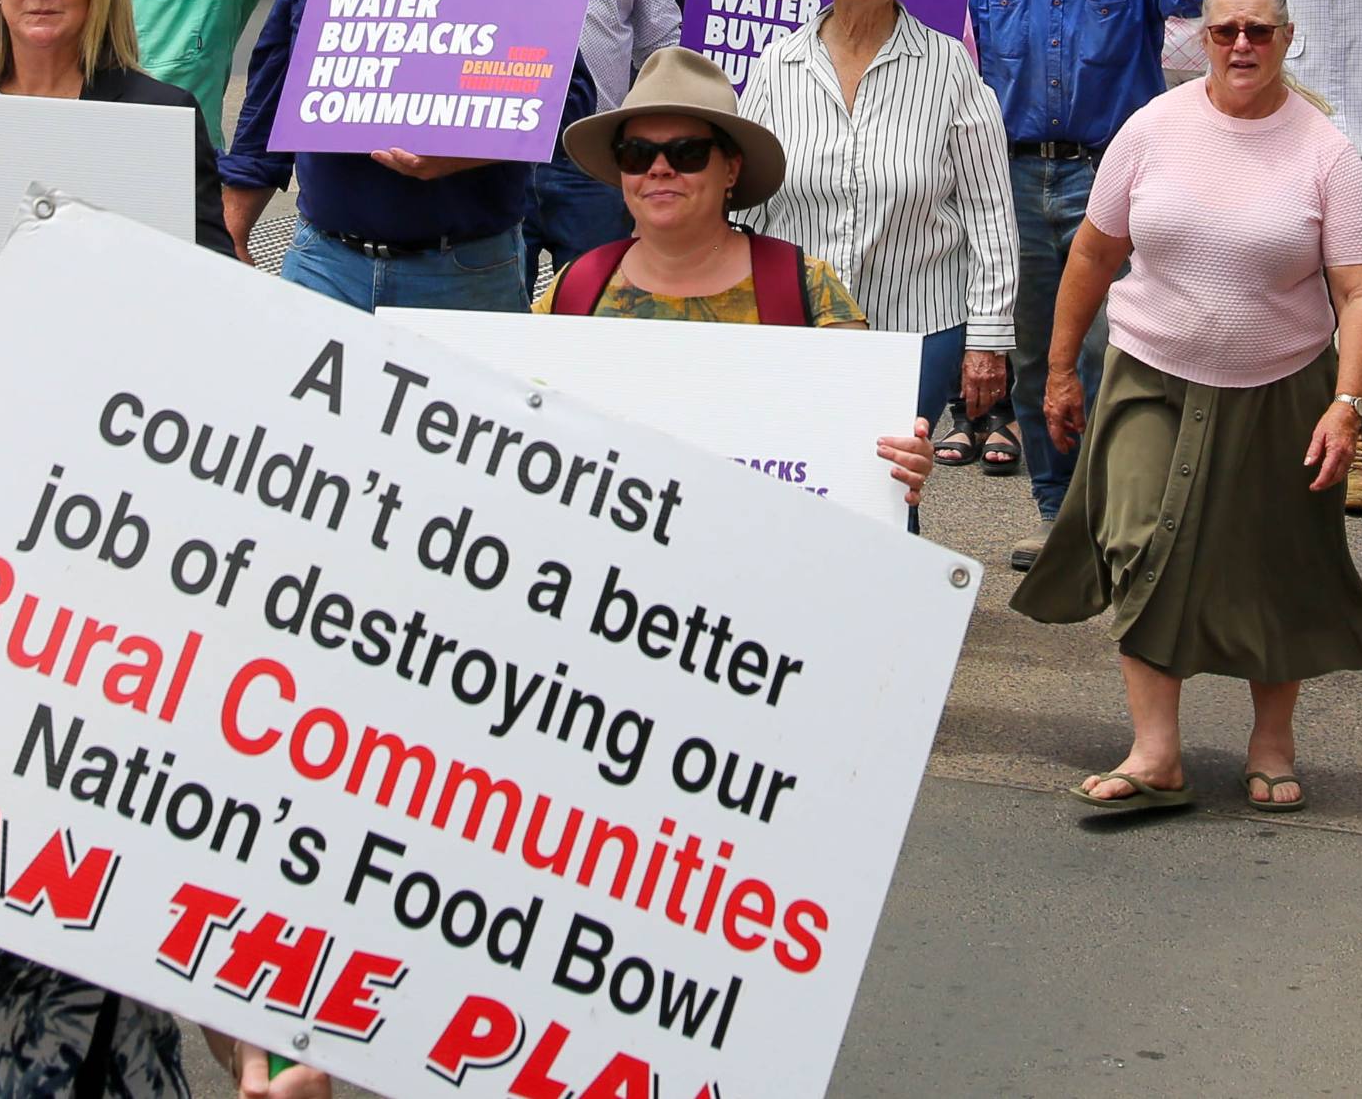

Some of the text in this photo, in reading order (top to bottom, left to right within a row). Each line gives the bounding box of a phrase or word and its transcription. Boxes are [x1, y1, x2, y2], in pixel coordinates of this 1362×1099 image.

[299, 91, 543, 131] COMMUNITIES
[307, 57, 401, 88] HURT
[317, 22, 498, 56] BUYBACKS
[462, 60, 554, 78] DENILIQUIN
[98, 390, 804, 707] couldn't do a better
[291, 338, 684, 546] A Terrorist
[18, 463, 797, 824] job of destroying our
[13, 702, 325, 888] Nation's
[344, 830, 544, 969] Food
[553, 910, 743, 1050] Bowl
[220, 655, 830, 975] Communities
[156, 881, 408, 1043] THE
[426, 994, 728, 1099] PLA
